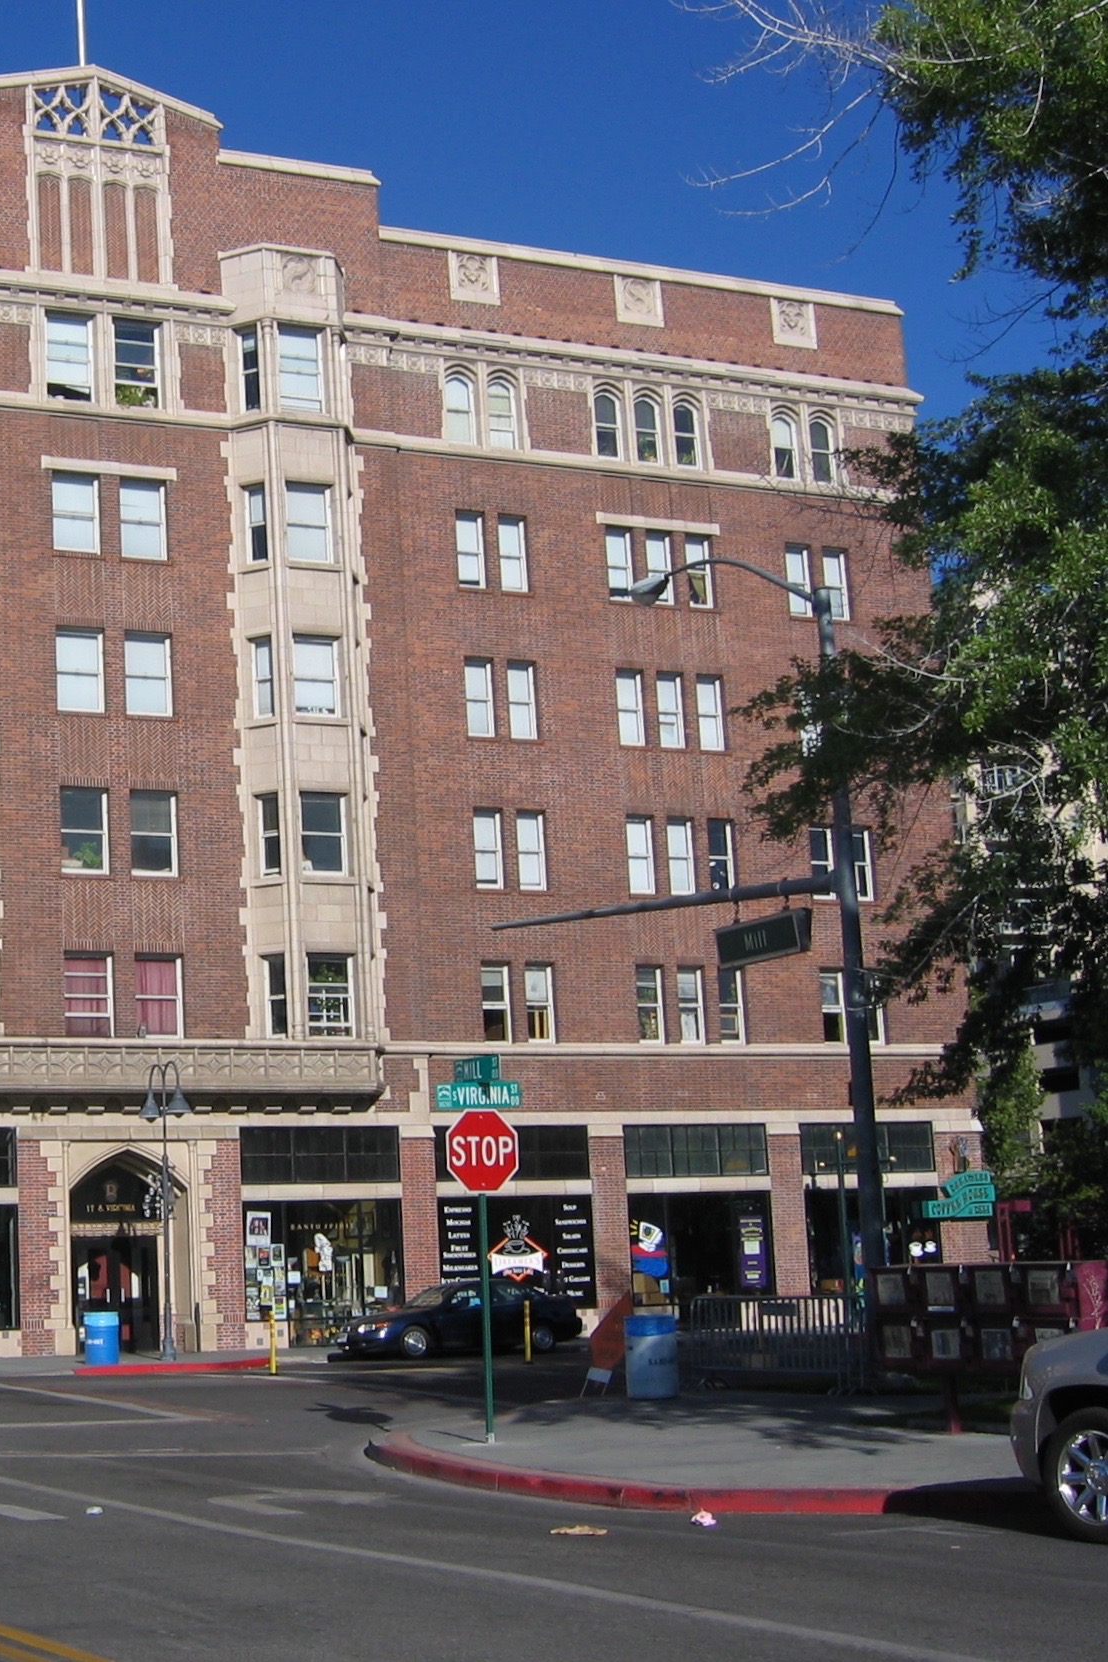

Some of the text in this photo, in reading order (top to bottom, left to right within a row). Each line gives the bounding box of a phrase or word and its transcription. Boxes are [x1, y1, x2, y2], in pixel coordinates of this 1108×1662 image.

[744, 929, 767, 951] Mill
[463, 1060, 482, 1080] MILL
[452, 1086, 510, 1106] S VIRGINIA
[451, 1135, 513, 1167] STOP
